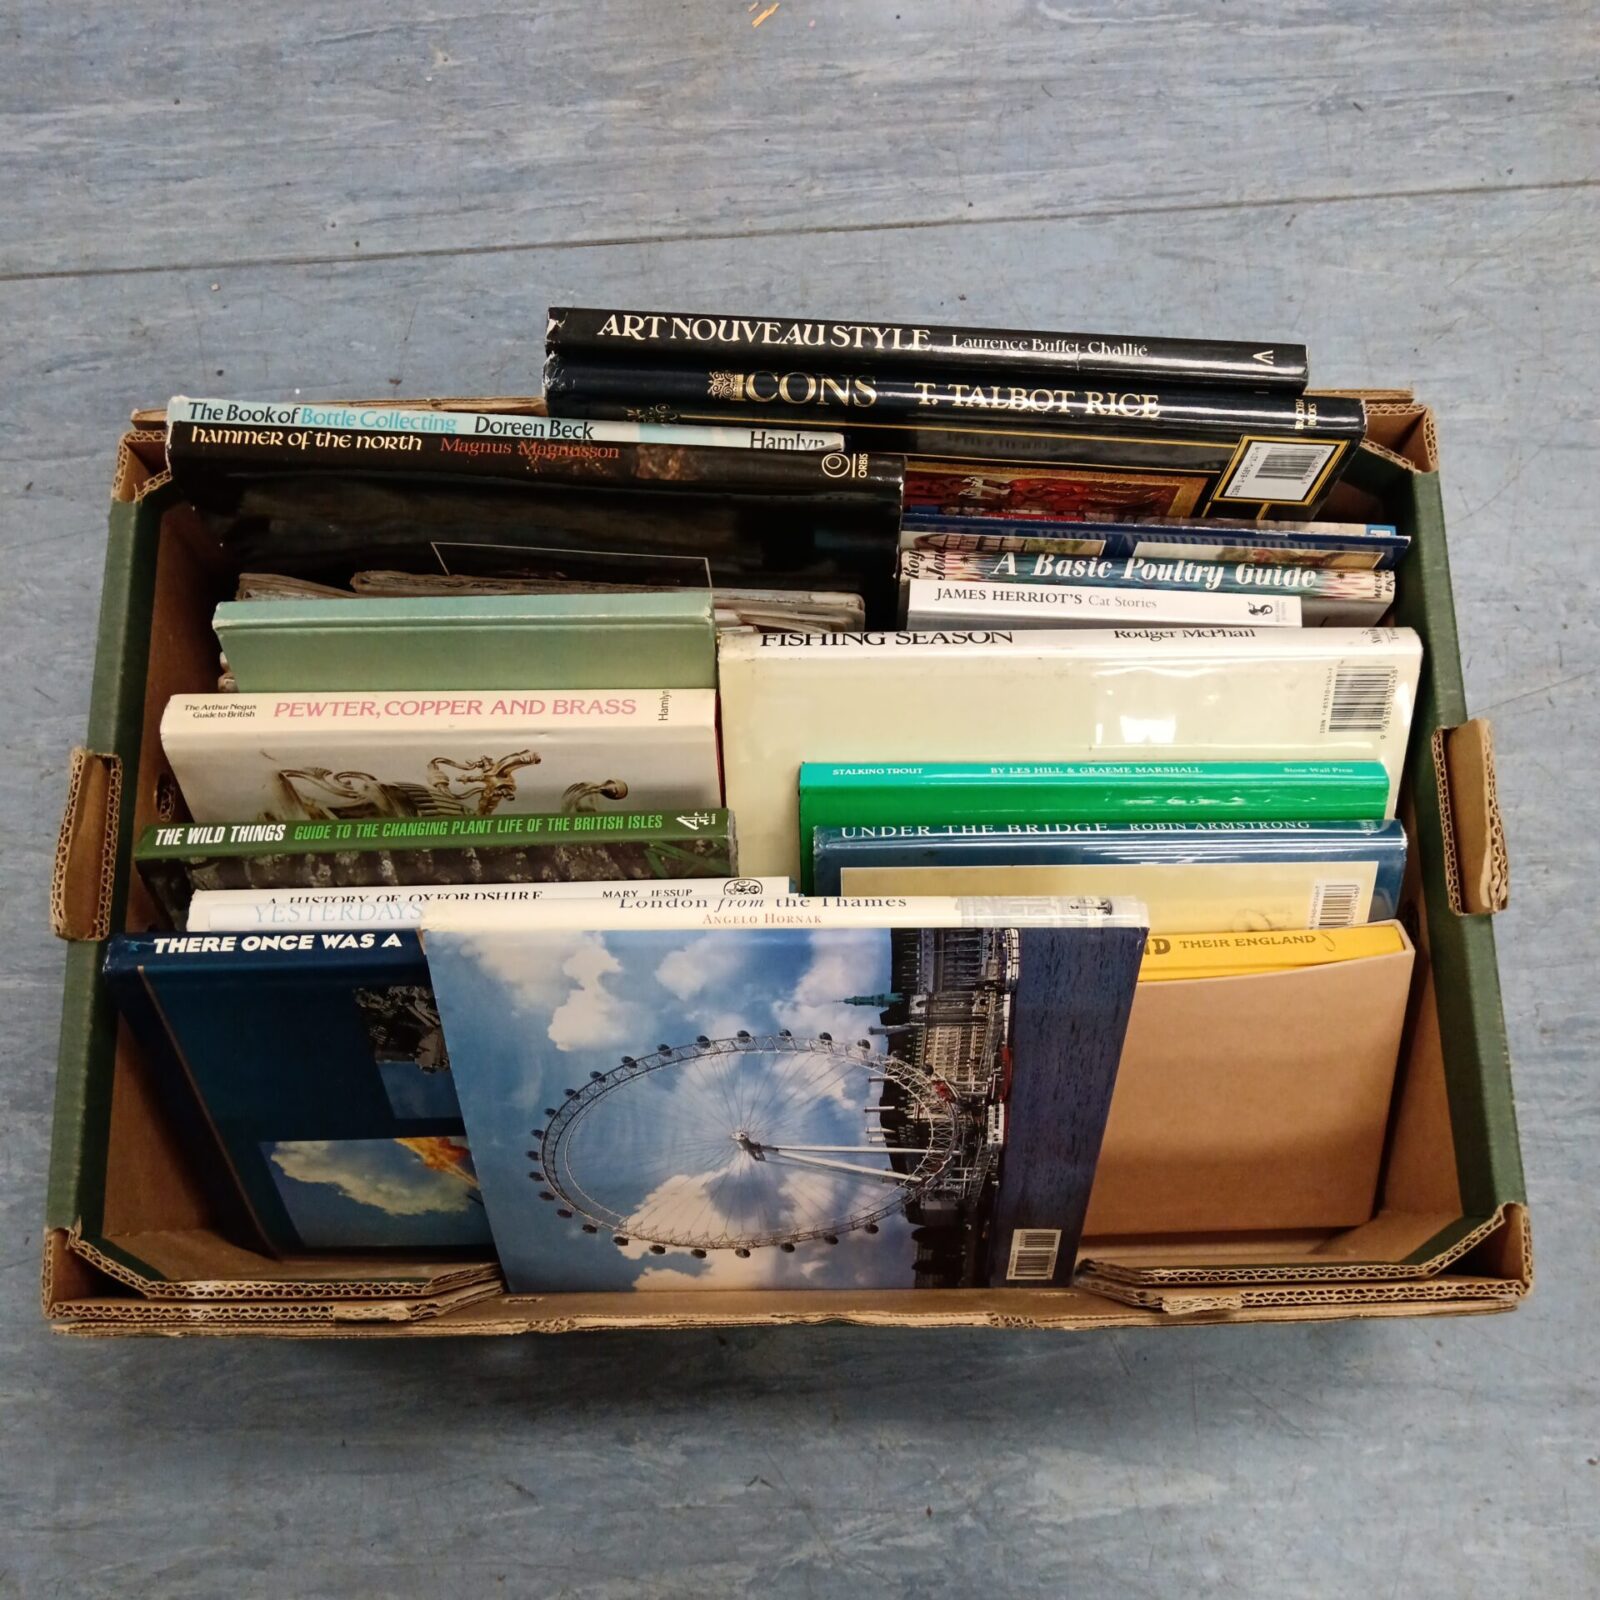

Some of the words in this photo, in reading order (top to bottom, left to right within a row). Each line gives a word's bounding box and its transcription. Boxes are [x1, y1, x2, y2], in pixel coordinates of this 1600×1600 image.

[597, 314, 667, 341] ART
[671, 317, 826, 346] NOUVEAU
[830, 324, 933, 351] STYLE
[951, 334, 1028, 351] Laurence
[732, 370, 878, 408] ICONS
[914, 382, 938, 406] T.
[948, 383, 1076, 412] TALBOT
[1084, 390, 1161, 418] RICE
[188, 401, 224, 421] The
[226, 403, 277, 423] Book
[278, 406, 301, 425] of
[301, 408, 357, 428] Bottle
[359, 411, 457, 434] Collecting
[474, 416, 545, 437] Doreen
[549, 419, 595, 440] Beck
[287, 430, 313, 450] of
[314, 430, 352, 448] the
[440, 437, 512, 457] Magnus
[518, 440, 621, 460] Magnusson
[857, 452, 869, 479] ORBIS
[990, 551, 1018, 576] A
[1030, 553, 1114, 579] Basic
[1122, 557, 1225, 590] Poultry
[1235, 562, 1317, 587] Guide
[935, 587, 987, 601] JAMES
[992, 590, 1082, 605] HERRIOT'S
[1088, 594, 1111, 607] Cat
[1114, 595, 1158, 609] Stories
[760, 631, 886, 647] FISHING
[895, 630, 1014, 646] SEASON
[1114, 628, 1178, 642] Rodger
[184, 703, 200, 711] The
[201, 702, 229, 711] Arthur
[230, 702, 257, 712] Negus
[227, 710, 255, 718] British
[273, 700, 381, 719] PEWTER,
[384, 699, 483, 717] COPPER
[489, 699, 546, 715] AND
[551, 698, 637, 715] BRASS
[832, 768, 885, 776] STALKING
[887, 767, 924, 775] TROUT
[990, 766, 1006, 775] BY
[1009, 766, 1030, 775] LES
[1034, 766, 1064, 775] HILL
[1067, 766, 1075, 774] &
[1079, 766, 1132, 774] GRAEME
[1135, 766, 1204, 774] MARSHALL
[155, 827, 185, 846] THE
[186, 825, 226, 845] WILD
[230, 823, 287, 843] THINGS
[294, 824, 331, 840] GUIDE
[335, 824, 352, 839] TO
[355, 823, 380, 838] THE
[382, 821, 449, 837] CHANGING
[451, 819, 494, 834] PLANT
[497, 818, 524, 833] LIFE
[526, 818, 544, 832] OF
[547, 817, 571, 831] THE
[573, 815, 625, 830] BRITISH
[627, 814, 663, 829] ISLES
[841, 824, 931, 839] UNDER
[942, 823, 995, 834] THE
[1007, 822, 1110, 834] BRIDGE
[1129, 822, 1187, 832] ROBIN
[1194, 820, 1311, 832] ARMSTRONG
[602, 889, 640, 899] MARY
[618, 897, 708, 909] London
[714, 897, 765, 912] from
[775, 896, 811, 908] the
[822, 896, 908, 908] Thames
[254, 900, 424, 923] YESTERDAYS
[702, 913, 758, 924] ANGELO
[764, 913, 822, 924] HORNAK
[153, 935, 237, 954] THERE
[241, 933, 315, 951] ONCE
[321, 932, 376, 949] WAS
[380, 932, 403, 948] A
[1179, 937, 1231, 950] THEIR
[1234, 934, 1317, 948] ENGLAND
